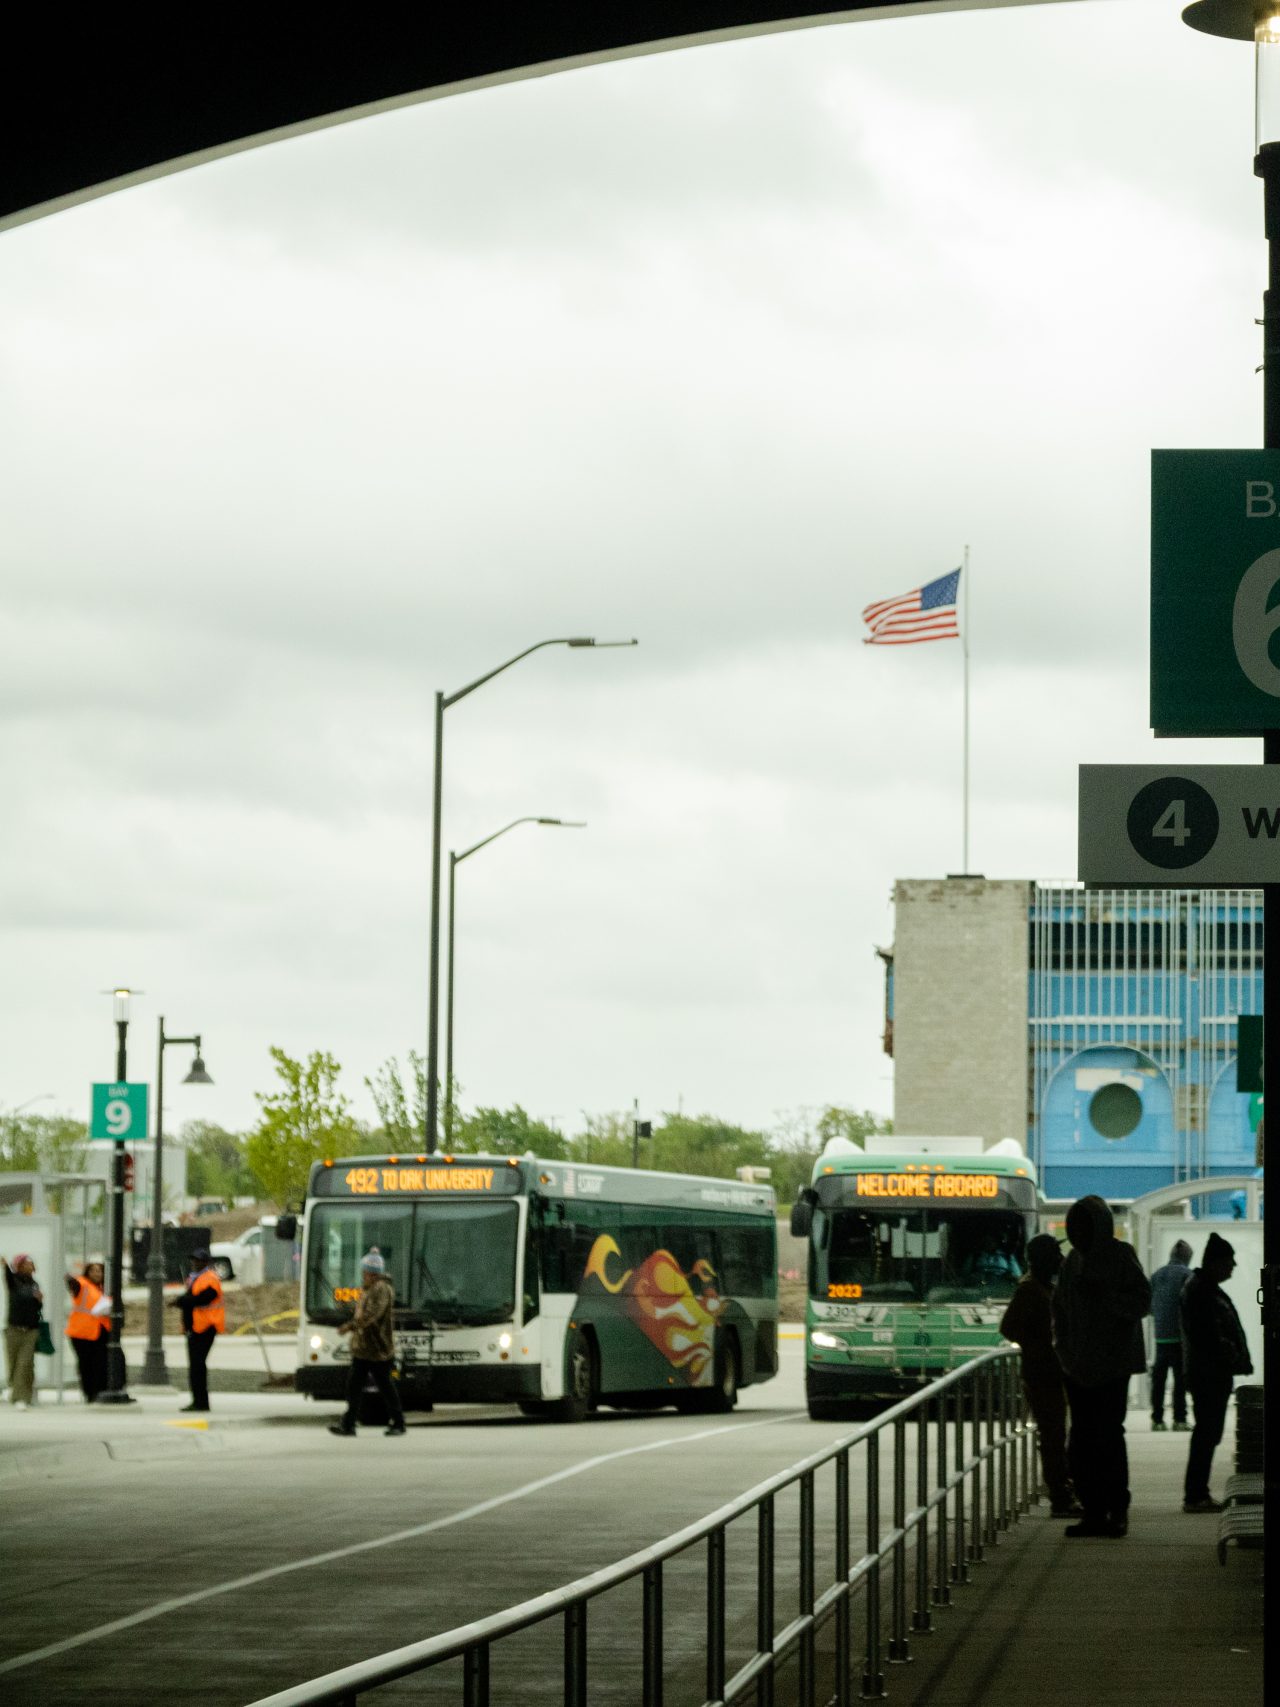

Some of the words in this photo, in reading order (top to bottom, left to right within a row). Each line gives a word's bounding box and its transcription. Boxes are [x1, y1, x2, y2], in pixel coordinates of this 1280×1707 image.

[1152, 800, 1190, 846] 4
[108, 1086, 129, 1098] BAY
[105, 1100, 132, 1135] 9
[346, 1168, 379, 1194] 492
[382, 1169, 399, 1190] TO
[400, 1169, 425, 1190] OAK
[425, 1169, 494, 1191] UNIVERSITY
[857, 1174, 931, 1197] WELCOME
[933, 1174, 998, 1198] ABOARD
